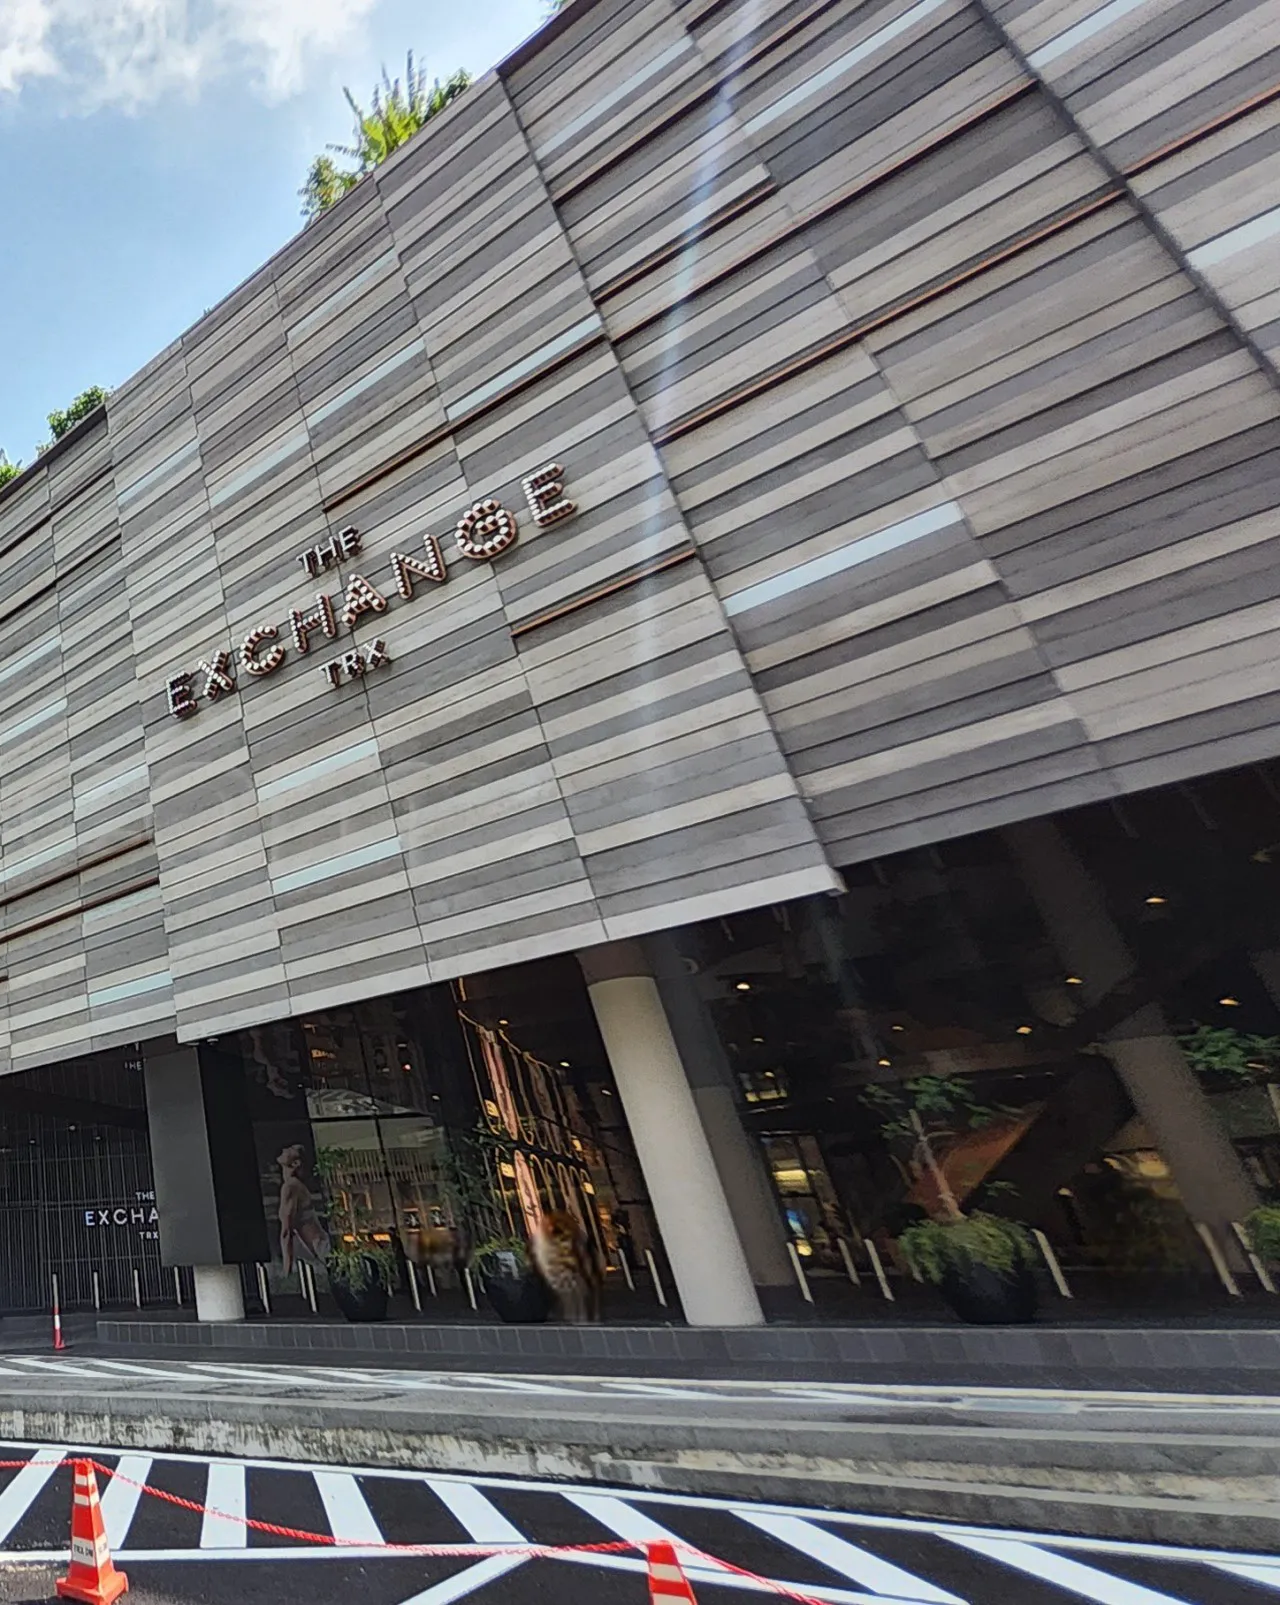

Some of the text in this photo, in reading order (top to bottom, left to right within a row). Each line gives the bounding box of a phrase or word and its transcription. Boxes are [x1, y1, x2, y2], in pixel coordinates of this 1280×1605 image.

[296, 524, 363, 579] THE
[166, 462, 578, 720] EXCHANGE
[320, 637, 393, 689] TRX
[135, 1191, 155, 1201] THE
[139, 1231, 158, 1240] TRX
